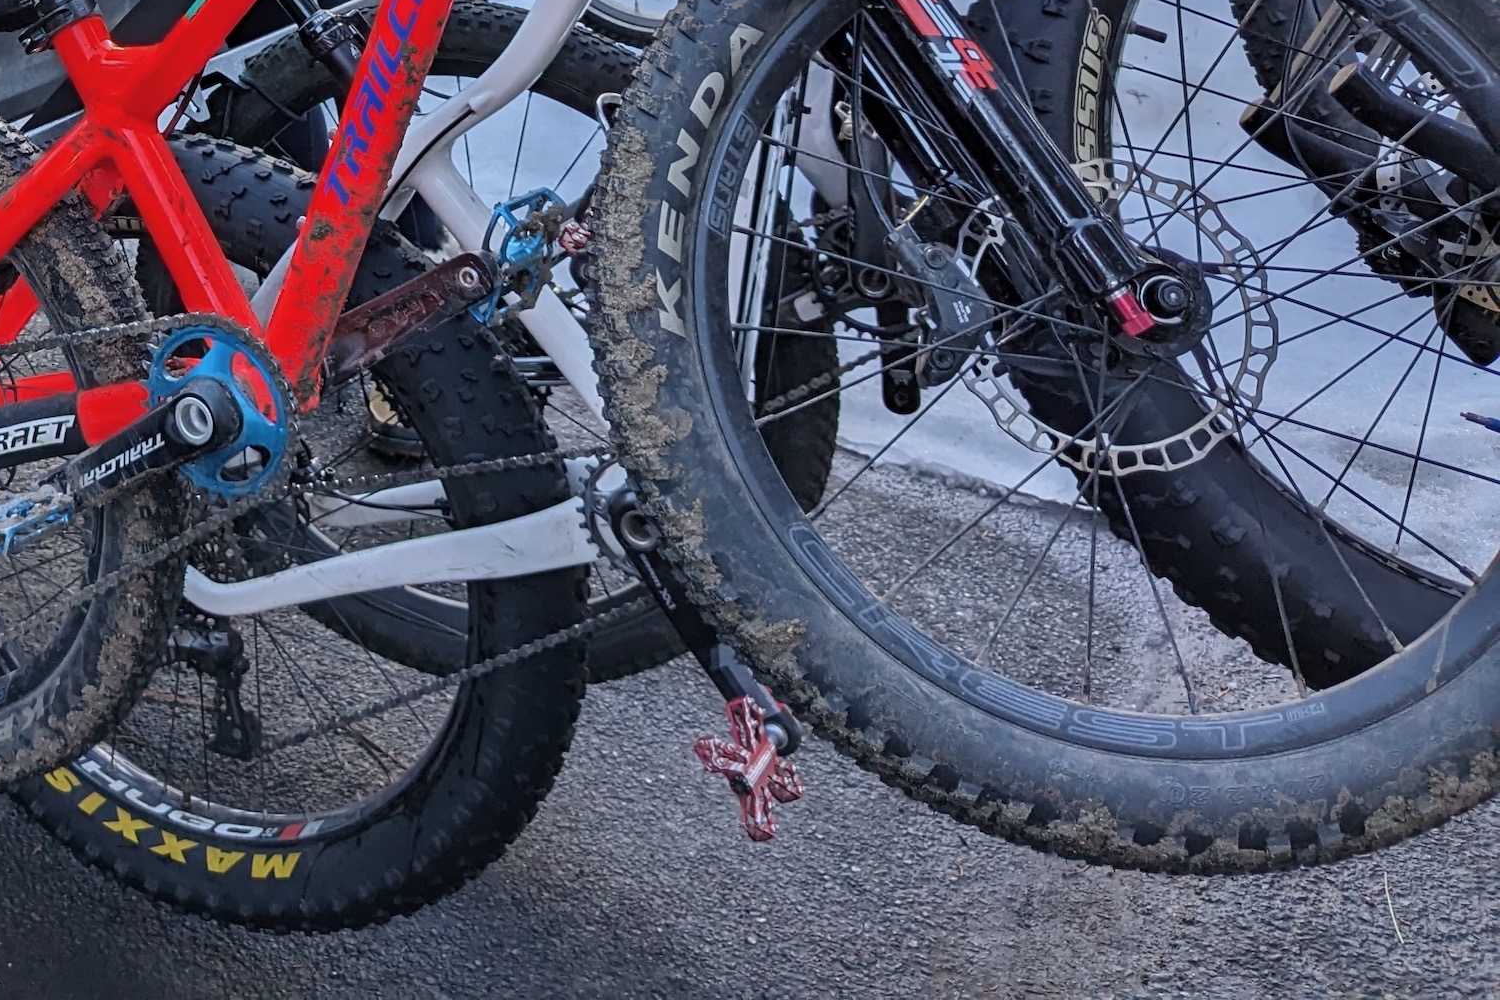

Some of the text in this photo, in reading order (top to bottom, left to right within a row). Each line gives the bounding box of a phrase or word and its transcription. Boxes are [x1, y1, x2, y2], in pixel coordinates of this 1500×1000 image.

[656, 22, 765, 339] KENDA
[80, 432, 165, 489] TRAILCRA
[44, 766, 302, 880] MAXXIS
